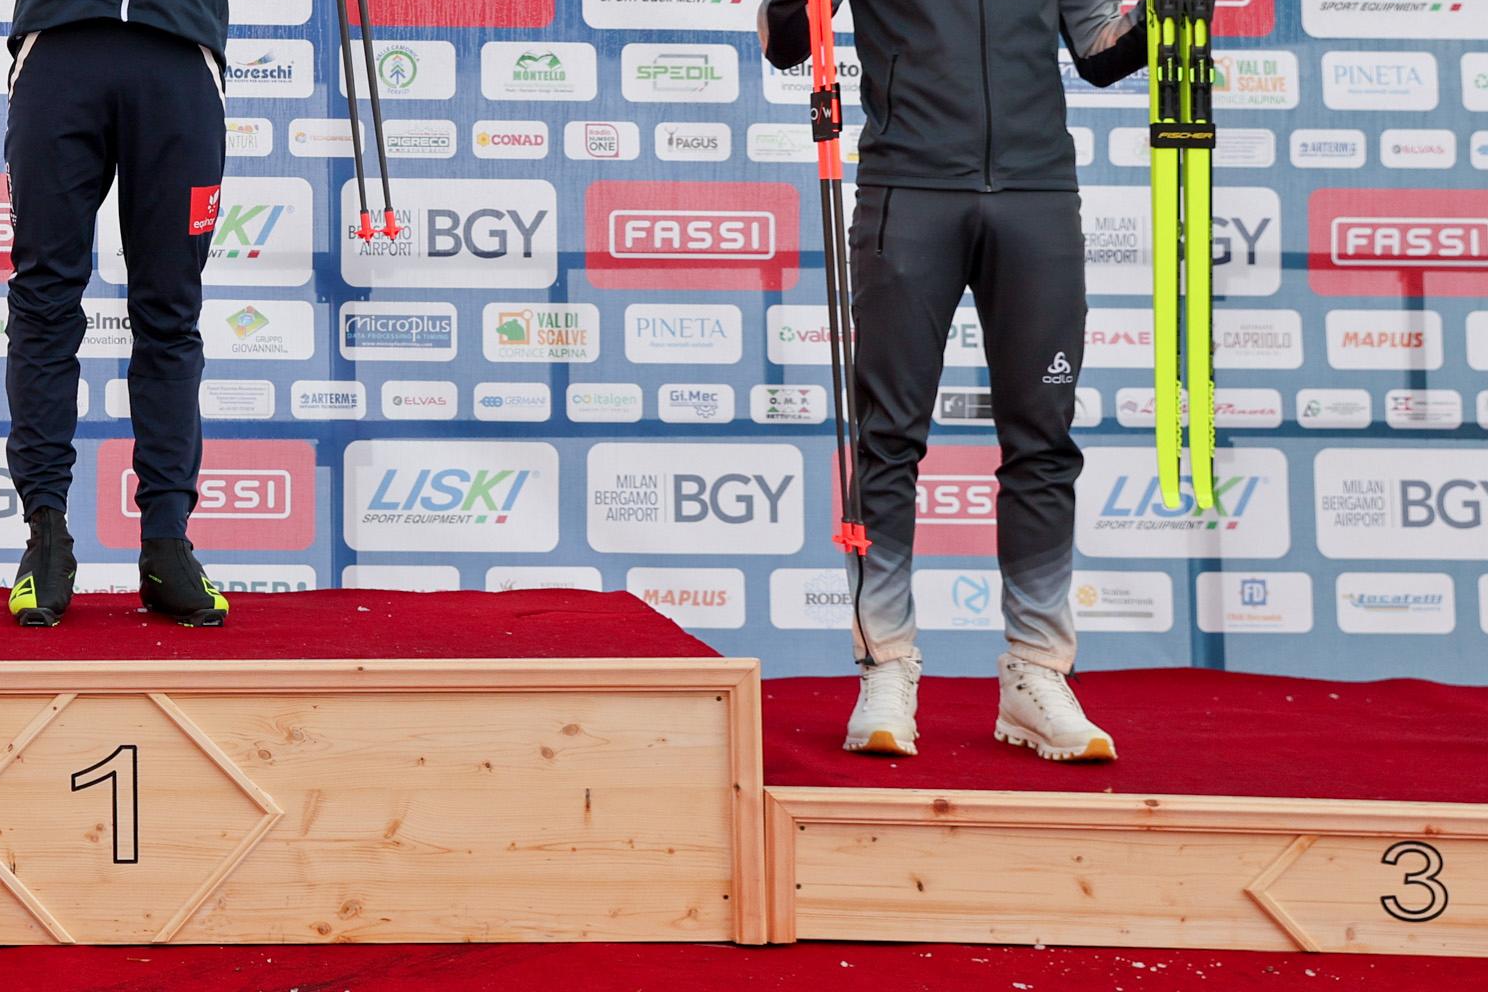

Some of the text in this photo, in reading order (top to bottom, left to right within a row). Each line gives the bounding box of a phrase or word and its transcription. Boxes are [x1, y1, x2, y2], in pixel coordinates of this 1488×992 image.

[636, 65, 722, 81] SPEDIL
[1236, 59, 1277, 75] VAL DI
[1333, 64, 1423, 86] PINETA
[513, 70, 566, 81] MONTELLO
[1237, 76, 1287, 92] SCALVE
[492, 134, 544, 146] CONAD
[589, 142, 616, 151] ONE
[676, 138, 718, 149] PAGUS
[427, 209, 548, 259] BGY
[625, 221, 759, 249] FASSI
[1346, 228, 1481, 256] FASSI
[537, 313, 579, 328] VAL DI
[637, 317, 727, 338] PINETA
[256, 336, 283, 344] GRUPPO
[538, 330, 587, 346] SCALVE
[1342, 332, 1424, 348] MAPLUS
[548, 348, 587, 359] ALPINA
[404, 397, 447, 405] ELVAS
[505, 397, 546, 406] GERMANI
[670, 390, 718, 402] Gi.Mec
[368, 469, 530, 511] LISKI
[616, 475, 657, 489] MILAN
[595, 490, 657, 506] BERGAMO
[673, 474, 794, 524] BGY
[1400, 479, 1488, 529] BG
[363, 514, 472, 525] SPORT EQUIPMENT
[606, 507, 659, 522] AIRPORT
[644, 589, 727, 606] MAPLUS
[805, 592, 853, 606] RODE
[71, 745, 138, 864] 1
[1380, 840, 1449, 923] 3
